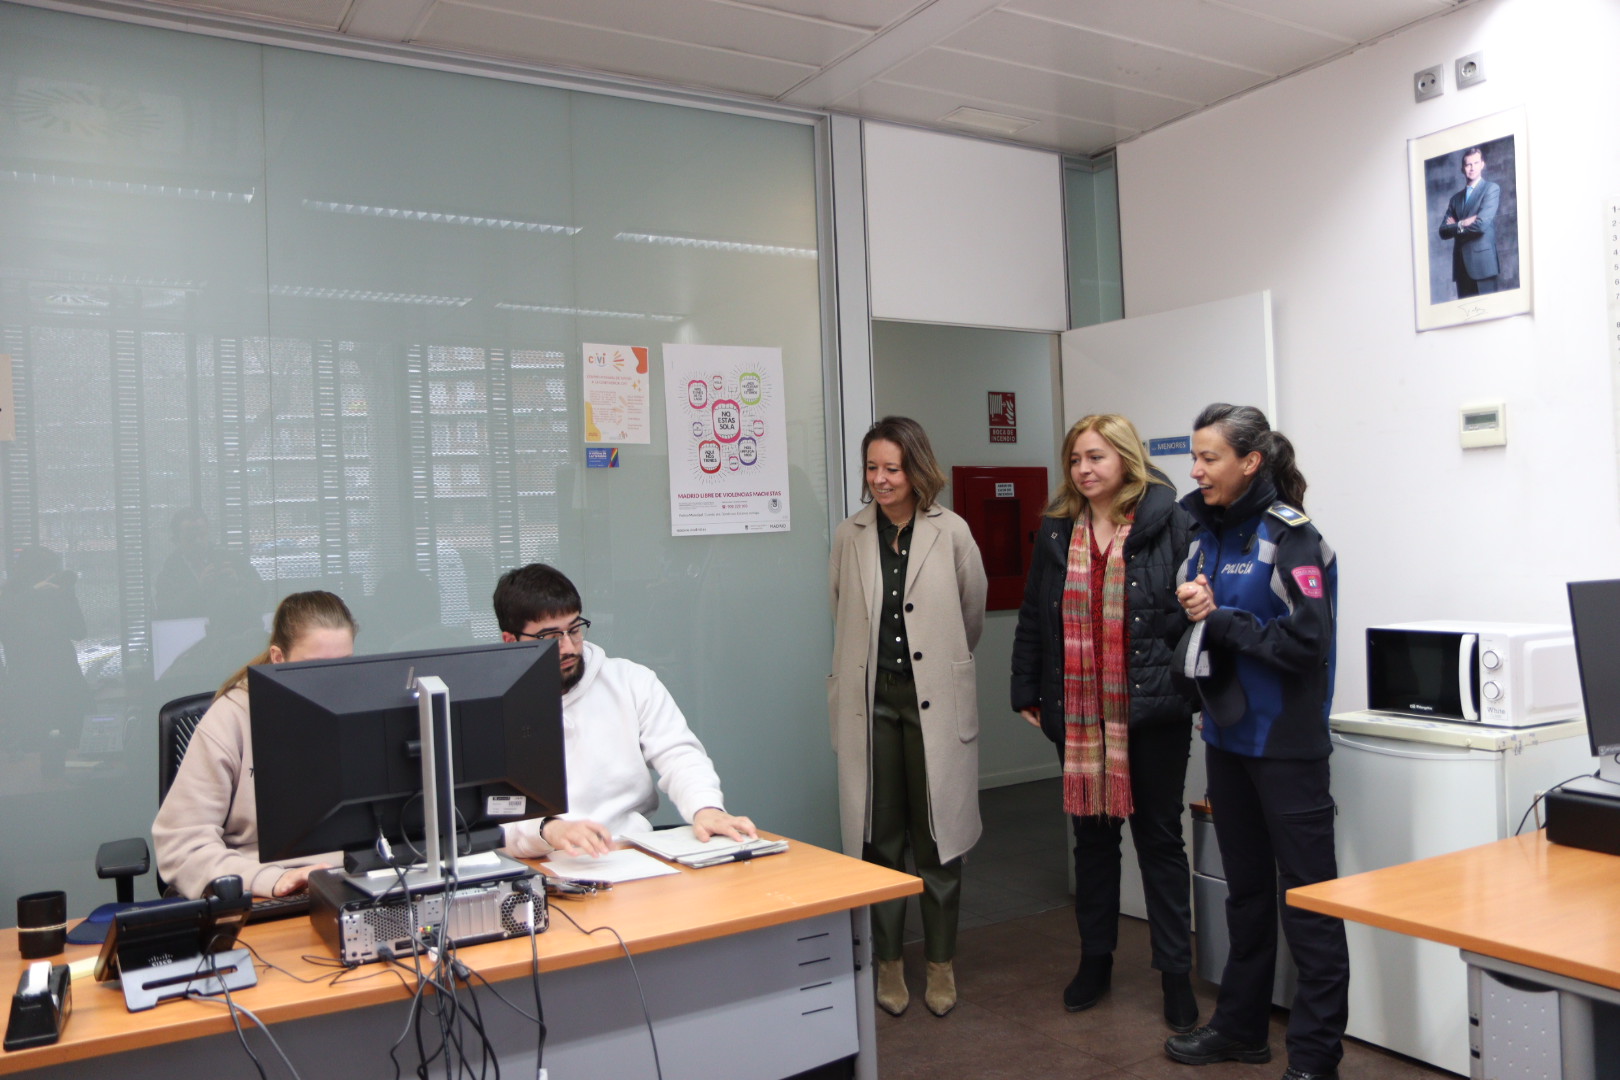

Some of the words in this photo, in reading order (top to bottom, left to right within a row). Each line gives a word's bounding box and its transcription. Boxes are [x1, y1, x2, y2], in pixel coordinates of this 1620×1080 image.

[1611, 219, 1617, 227] 2
[1157, 441, 1186, 450] MENORES
[1221, 560, 1254, 574] POLICÍA
